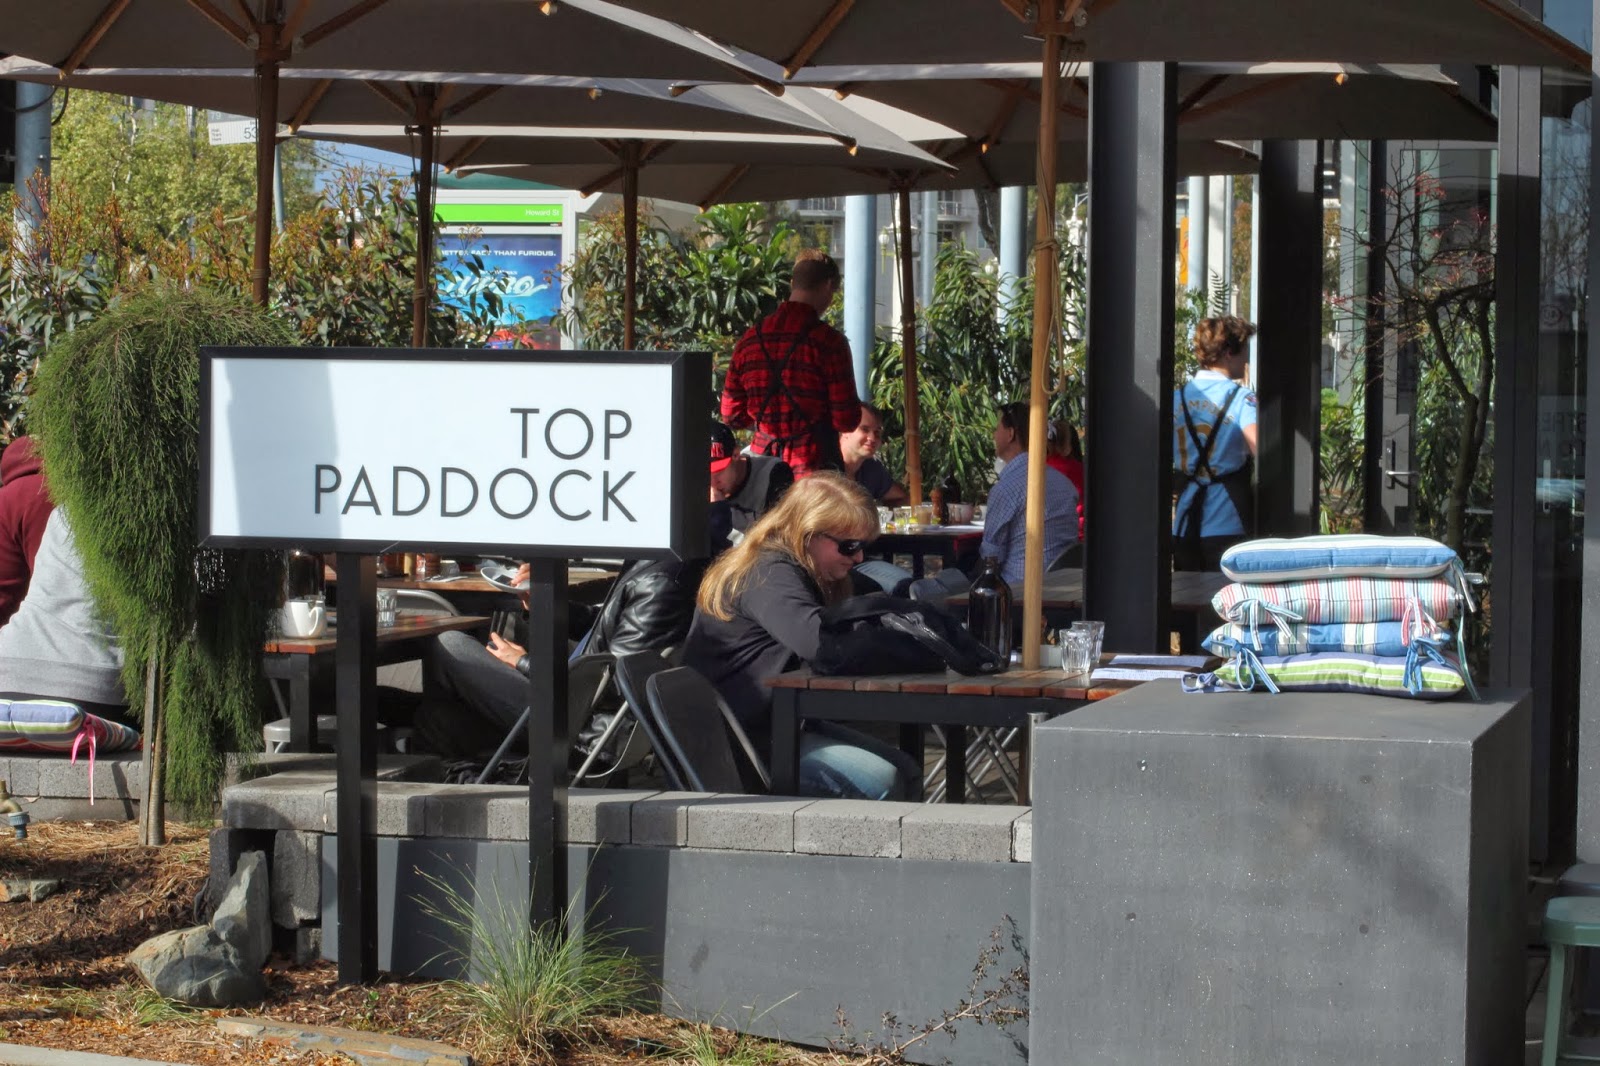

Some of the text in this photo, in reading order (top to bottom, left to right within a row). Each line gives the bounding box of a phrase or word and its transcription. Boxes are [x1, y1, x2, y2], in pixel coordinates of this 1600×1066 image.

[525, 208, 559, 216] Howard St
[510, 407, 632, 460] TOP
[314, 464, 637, 522] PADDOCK
